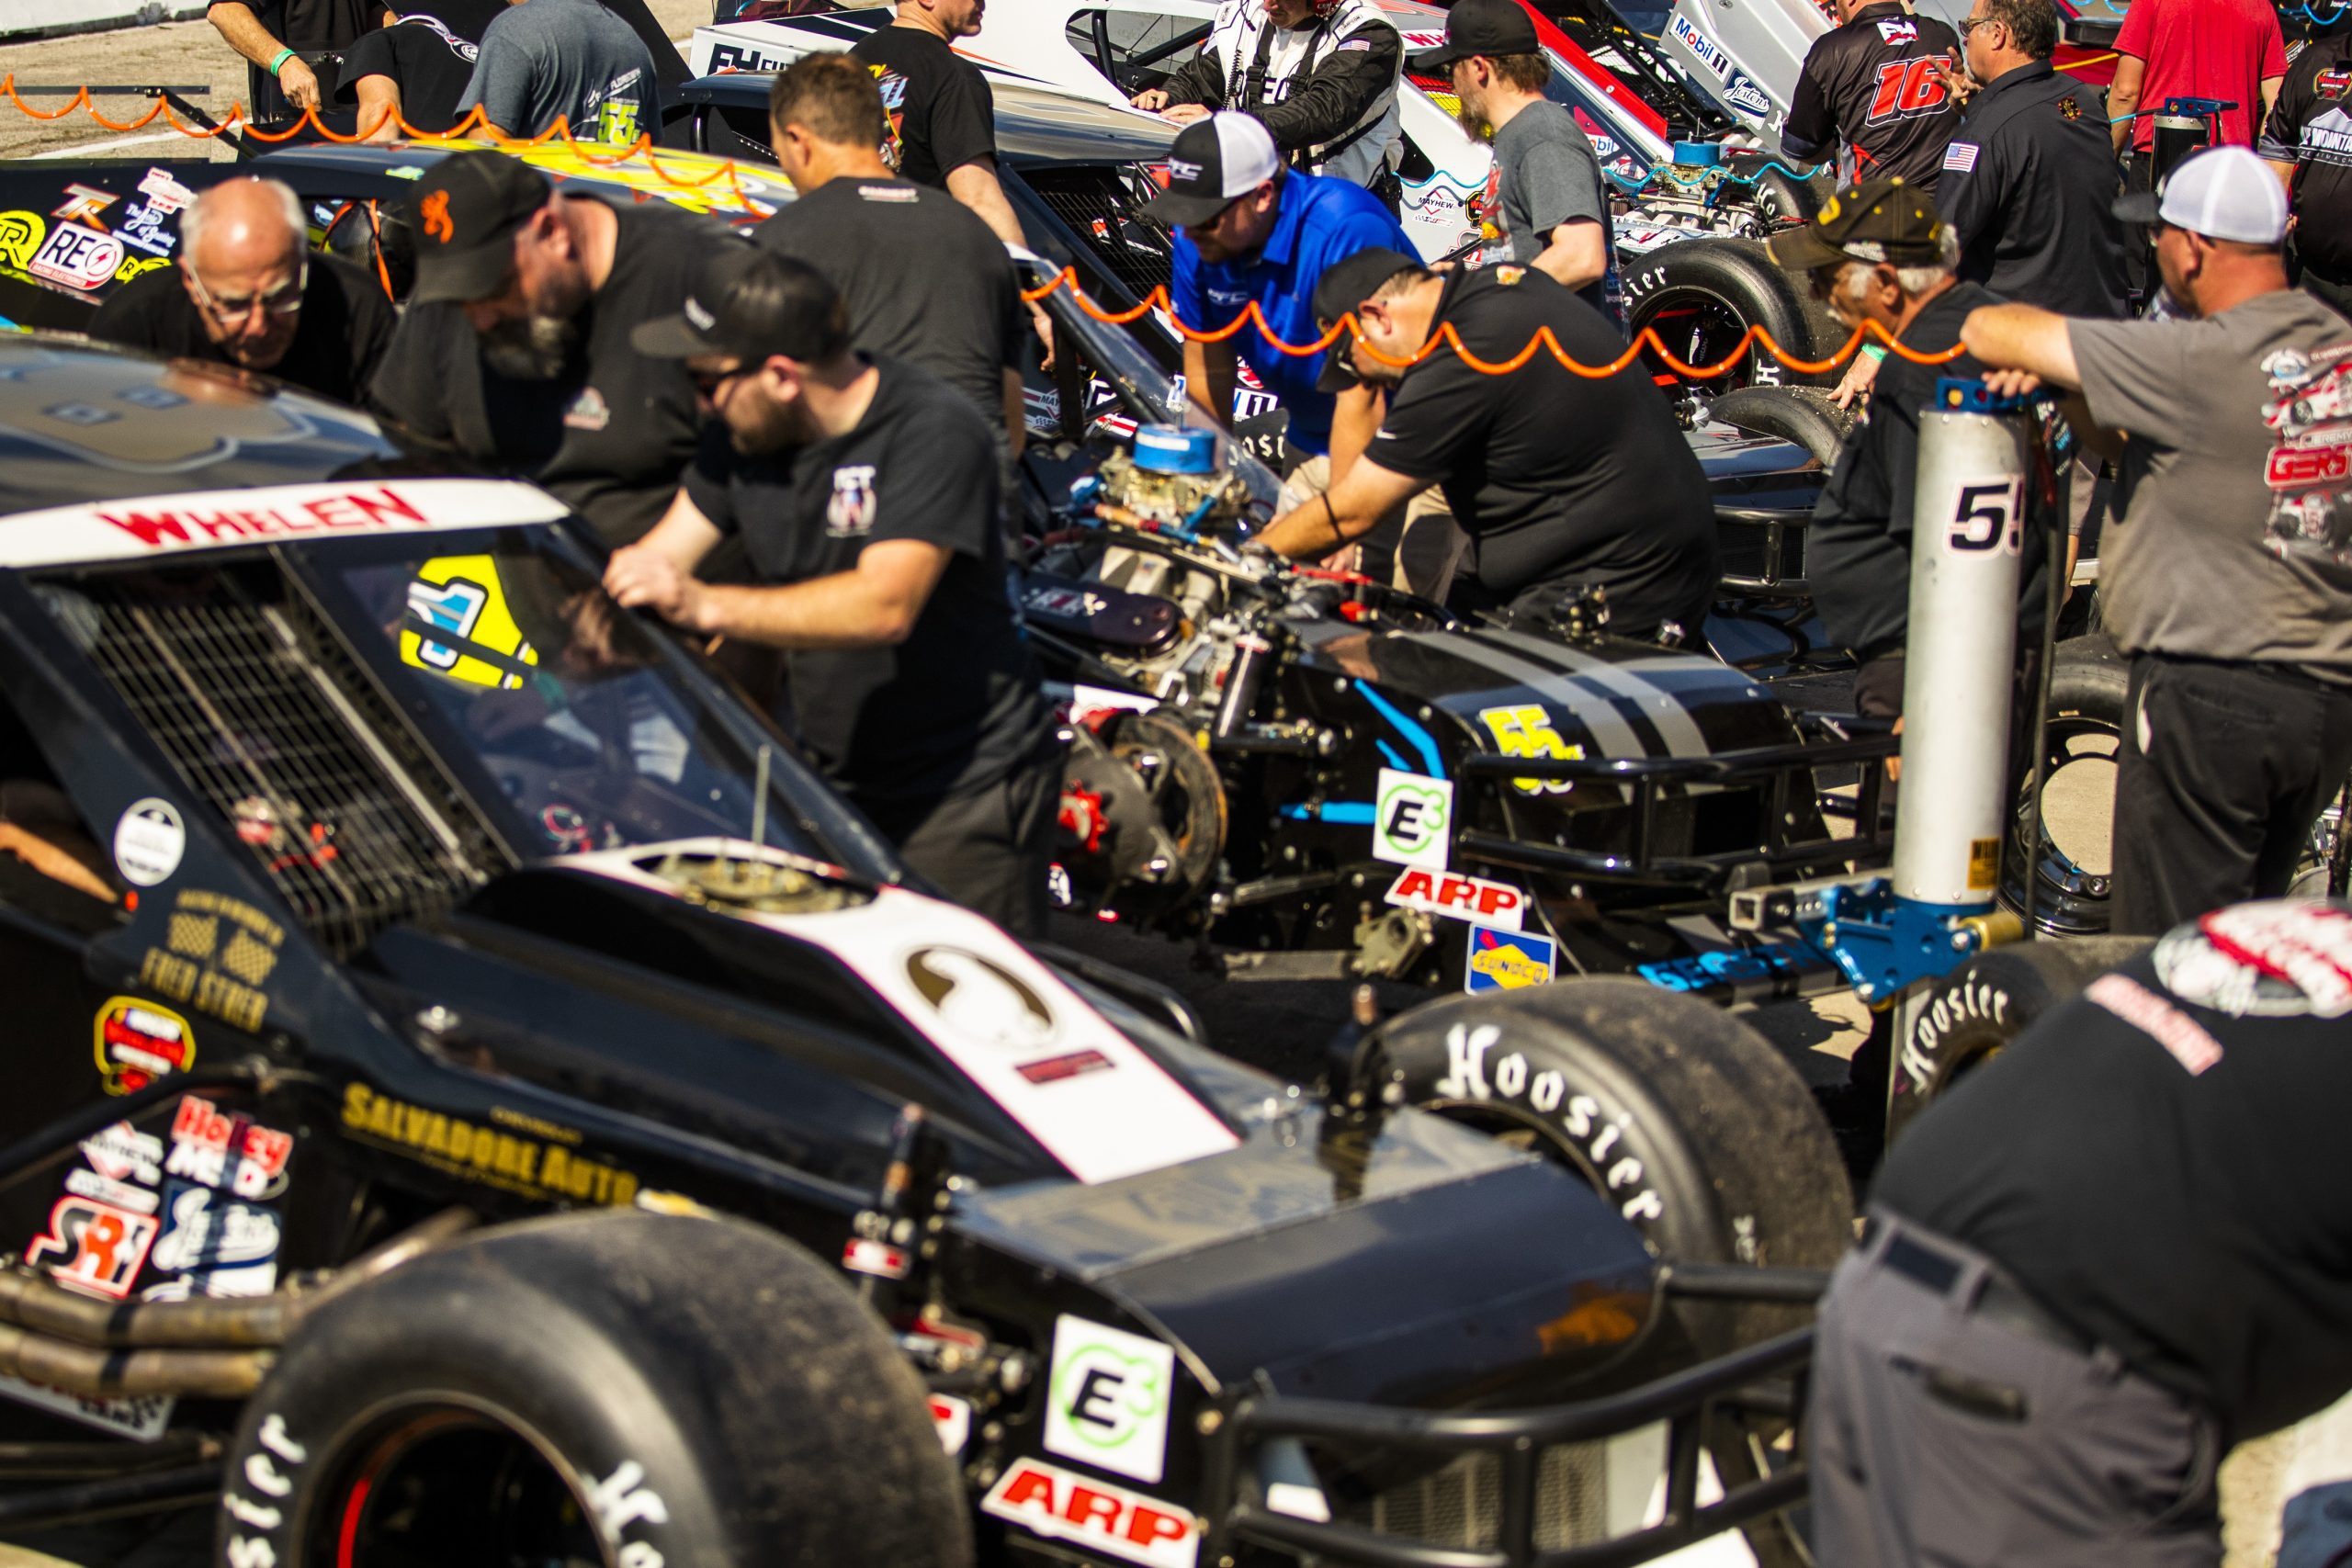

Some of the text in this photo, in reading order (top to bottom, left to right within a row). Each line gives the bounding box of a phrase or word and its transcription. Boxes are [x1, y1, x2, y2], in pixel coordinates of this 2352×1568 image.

[1674, 17, 1715, 62] Mobil
[1865, 55, 1953, 127] 16
[1590, 137, 1615, 153] obil
[1418, 197, 1454, 209] MAYHEW
[2266, 445, 2352, 485] GERS
[95, 486, 430, 547] WHELEN
[1396, 871, 1518, 916] ARP
[1476, 953, 1545, 986] SUNOCO
[1900, 968, 2009, 1097] Hoosier
[340, 1081, 539, 1183] SALVADORE
[539, 1145, 639, 1206] AUTO
[1435, 1021, 1664, 1220] Hoosier
[1002, 1469, 1189, 1547] ARP
